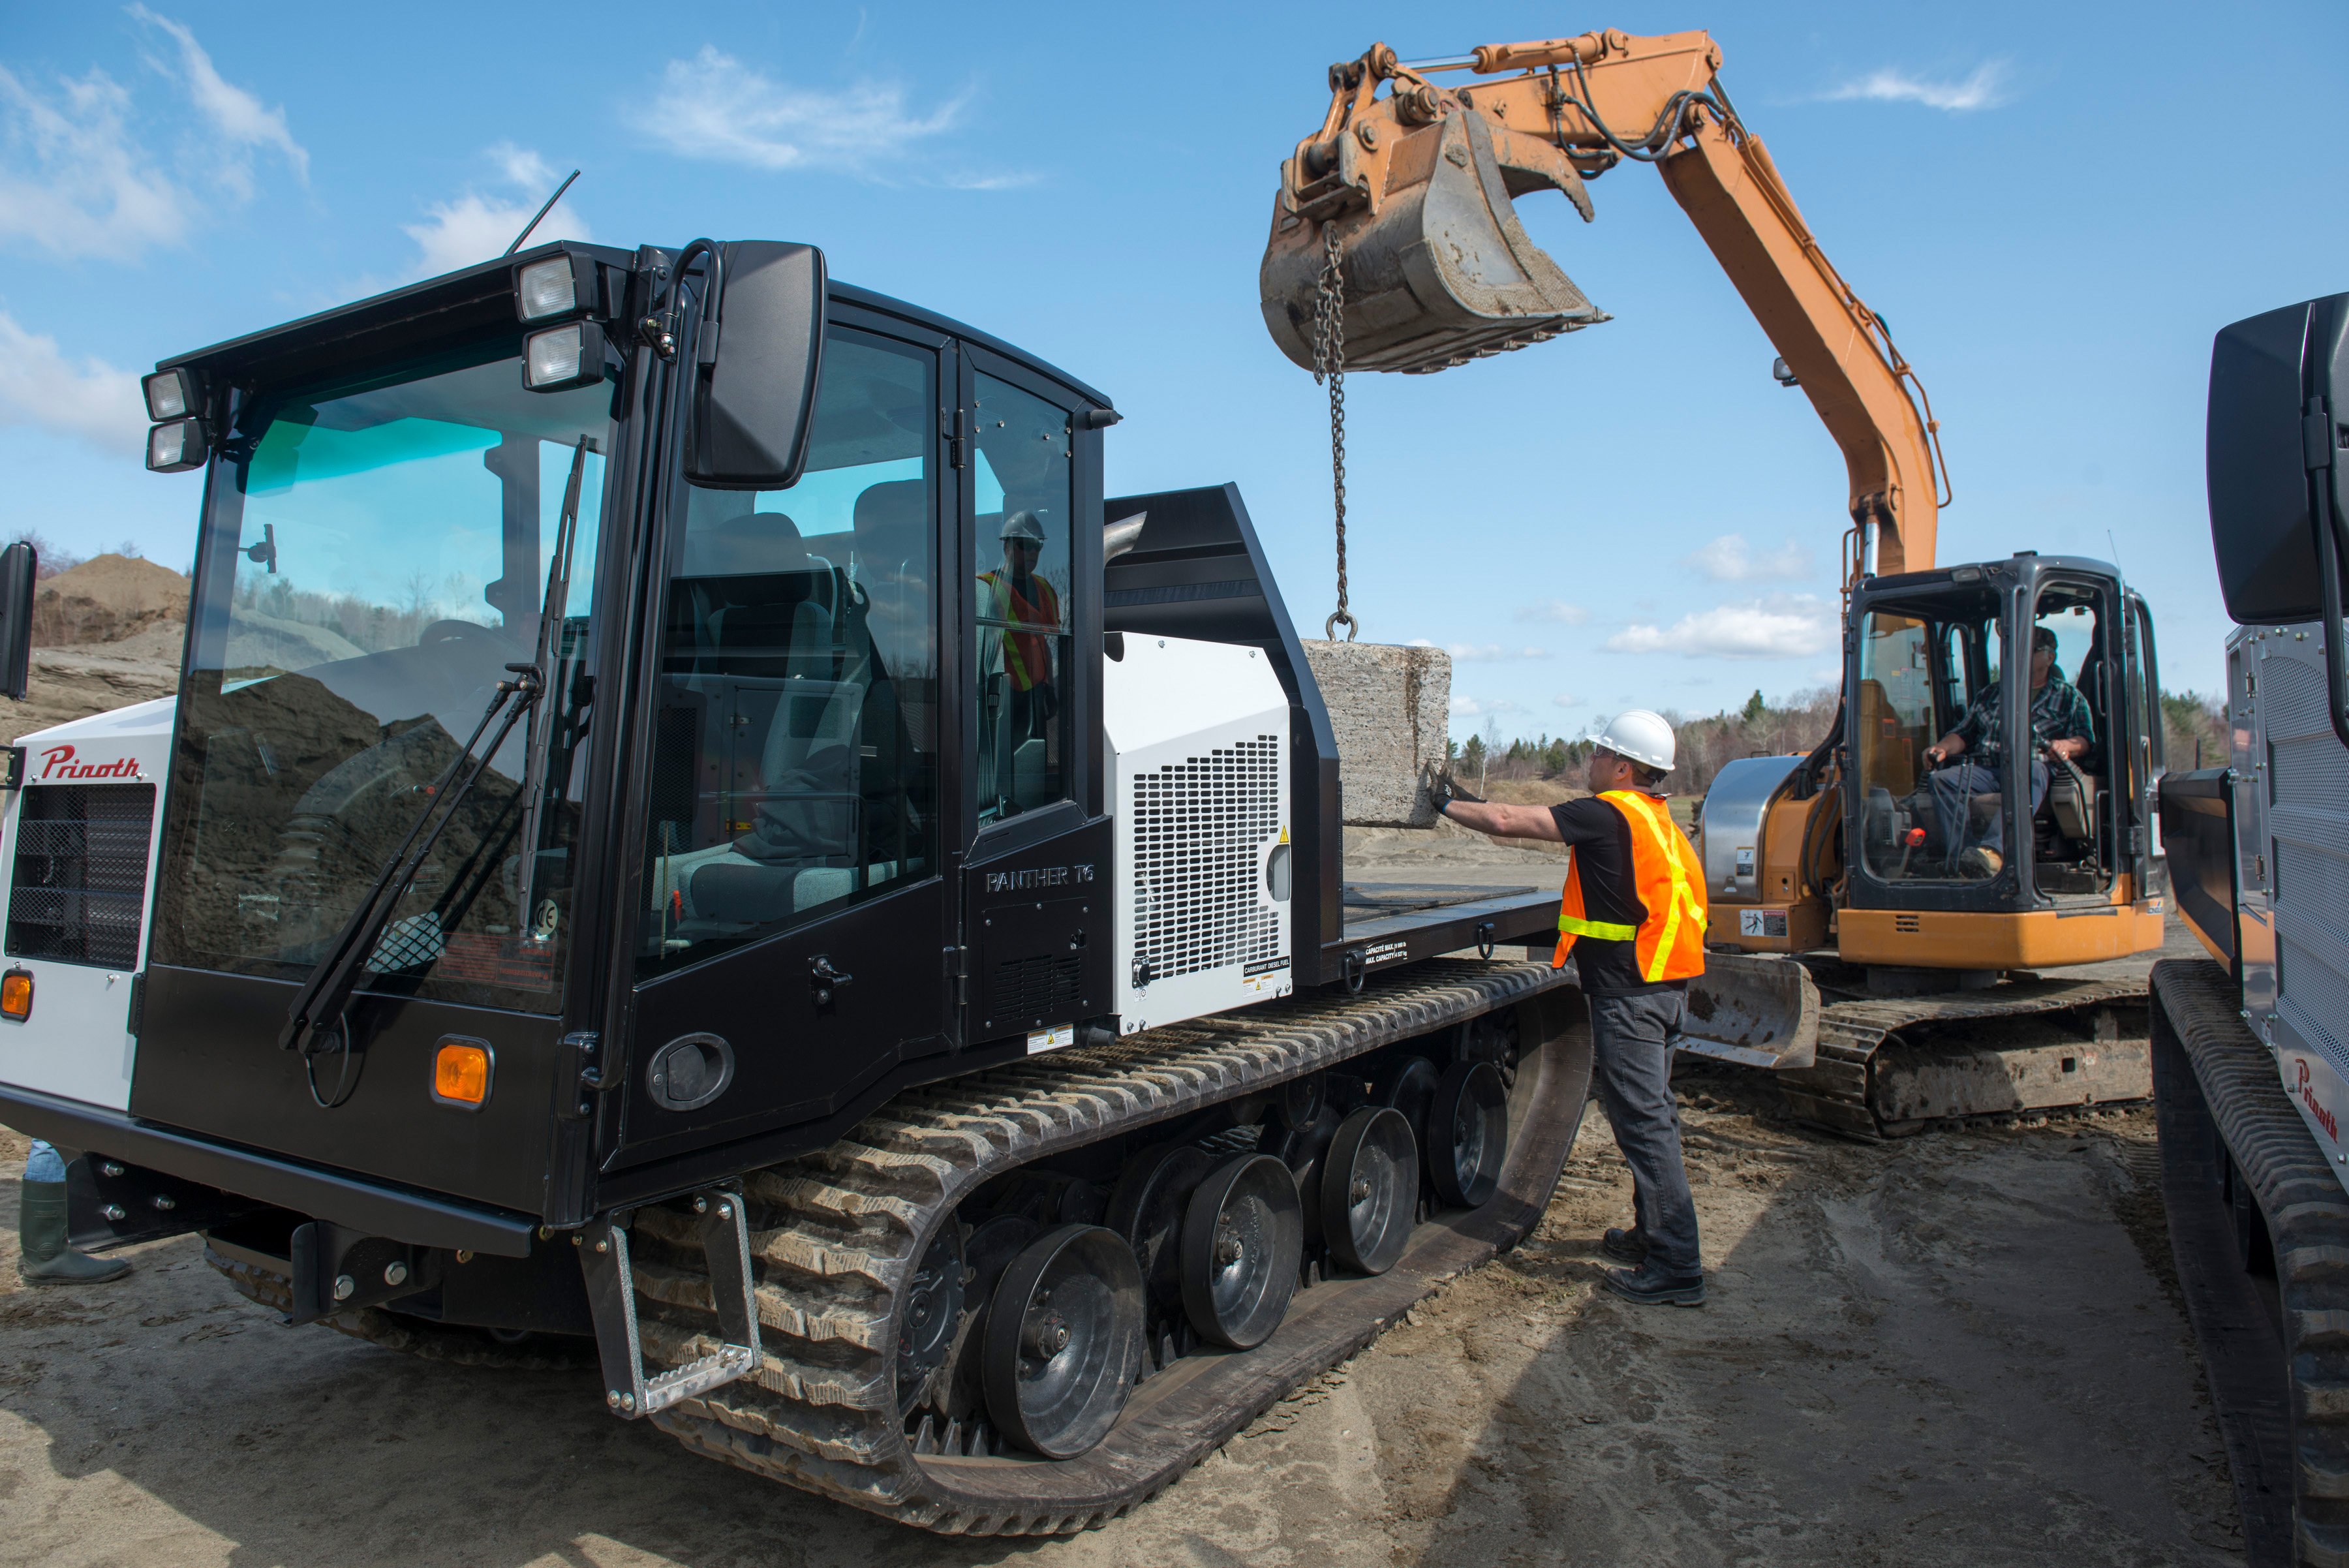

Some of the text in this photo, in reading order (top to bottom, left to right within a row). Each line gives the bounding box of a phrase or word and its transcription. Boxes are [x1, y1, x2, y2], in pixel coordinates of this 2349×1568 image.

[40, 745, 140, 779] Prinoth
[986, 864, 1095, 893] PANTHER T6
[1365, 944, 1385, 955] CAPACITÉ
[1385, 943, 1394, 951] MAX.
[1365, 957, 1375, 965] MAX.
[1375, 952, 1394, 962] CAPACITY
[1244, 964, 1267, 974] CARBURANT
[2295, 1058, 2338, 1145] Prinoth
